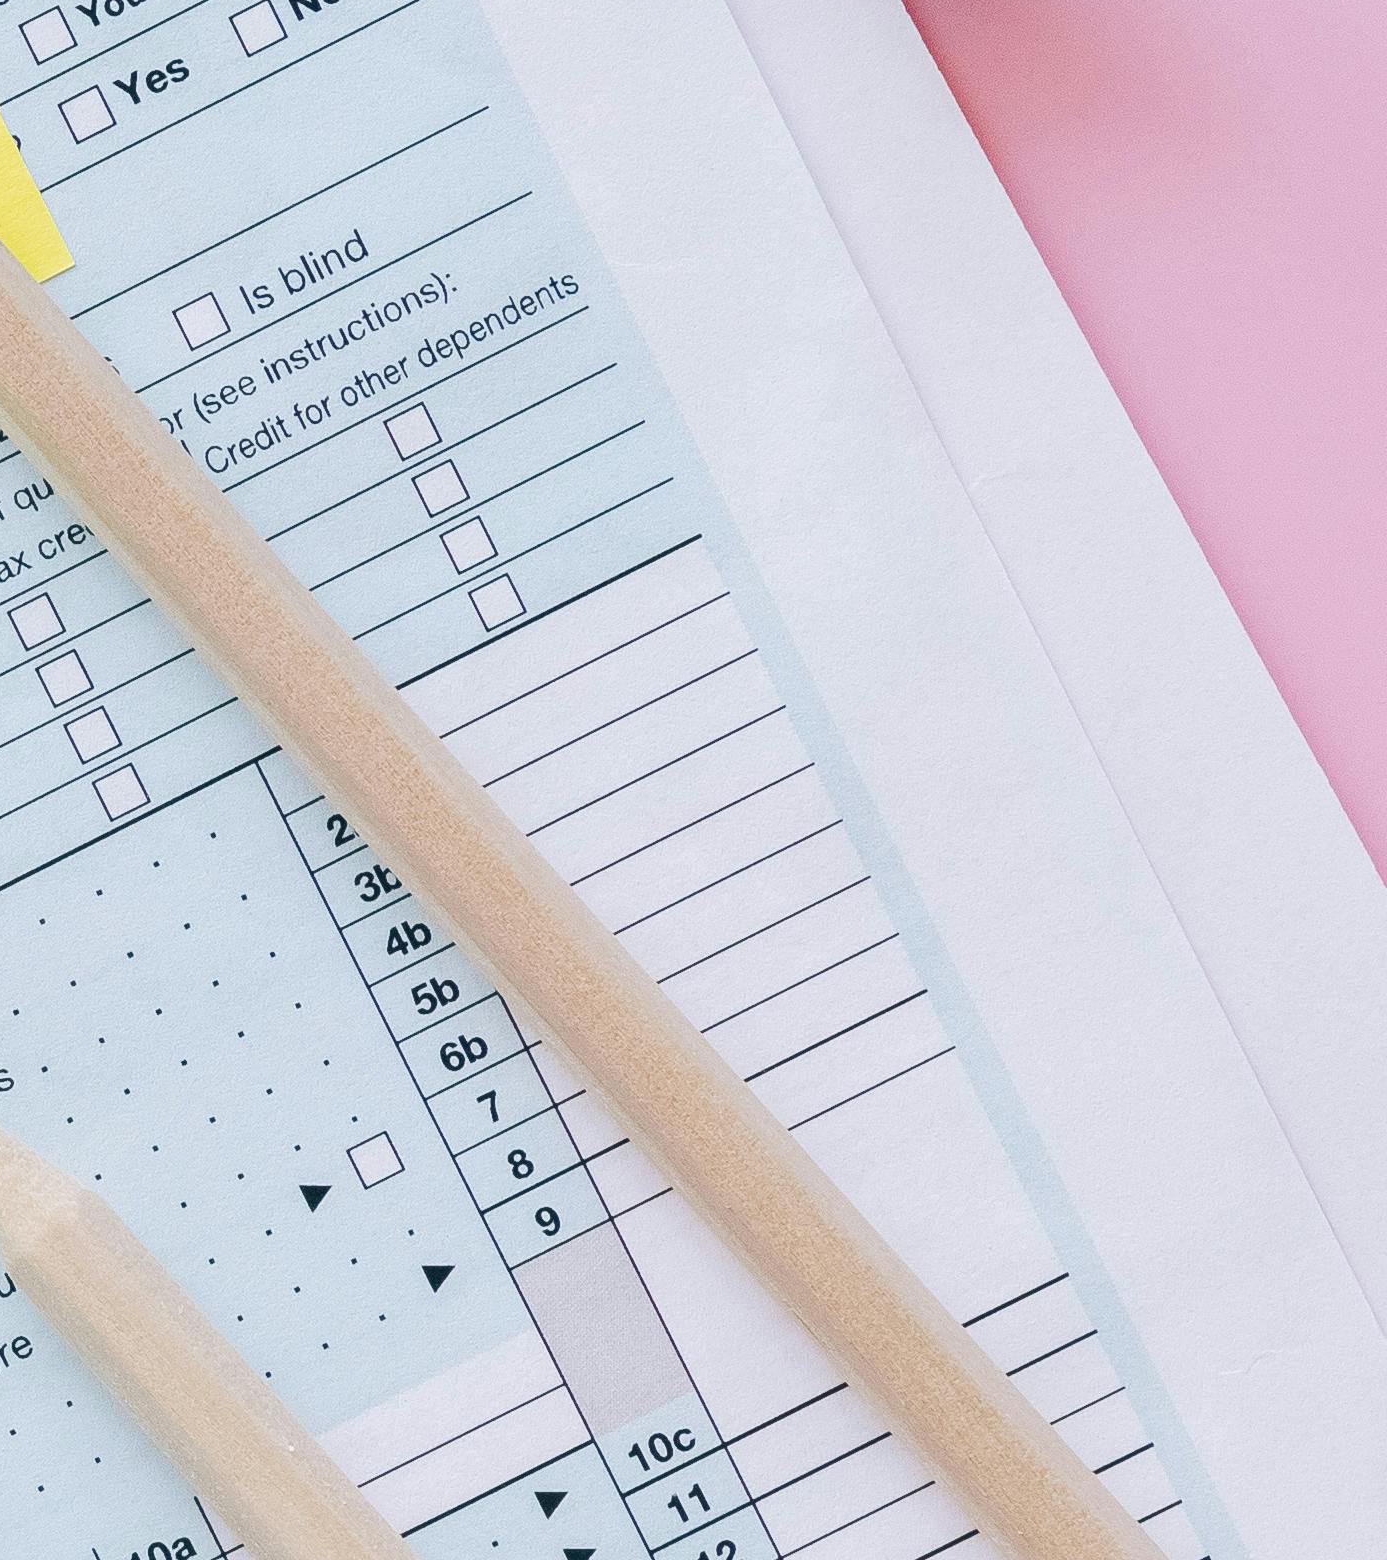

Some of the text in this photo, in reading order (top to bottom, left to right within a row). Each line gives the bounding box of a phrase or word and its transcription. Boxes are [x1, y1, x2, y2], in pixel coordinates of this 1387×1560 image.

[111, 57, 191, 106] Yes
[237, 227, 371, 316] Is blind
[203, 273, 581, 476] Credit for other dependents
[385, 919, 433, 957] 4b
[438, 1033, 490, 1073] 6b
[506, 1147, 536, 1181] 8
[626, 1427, 697, 1473] 10c
